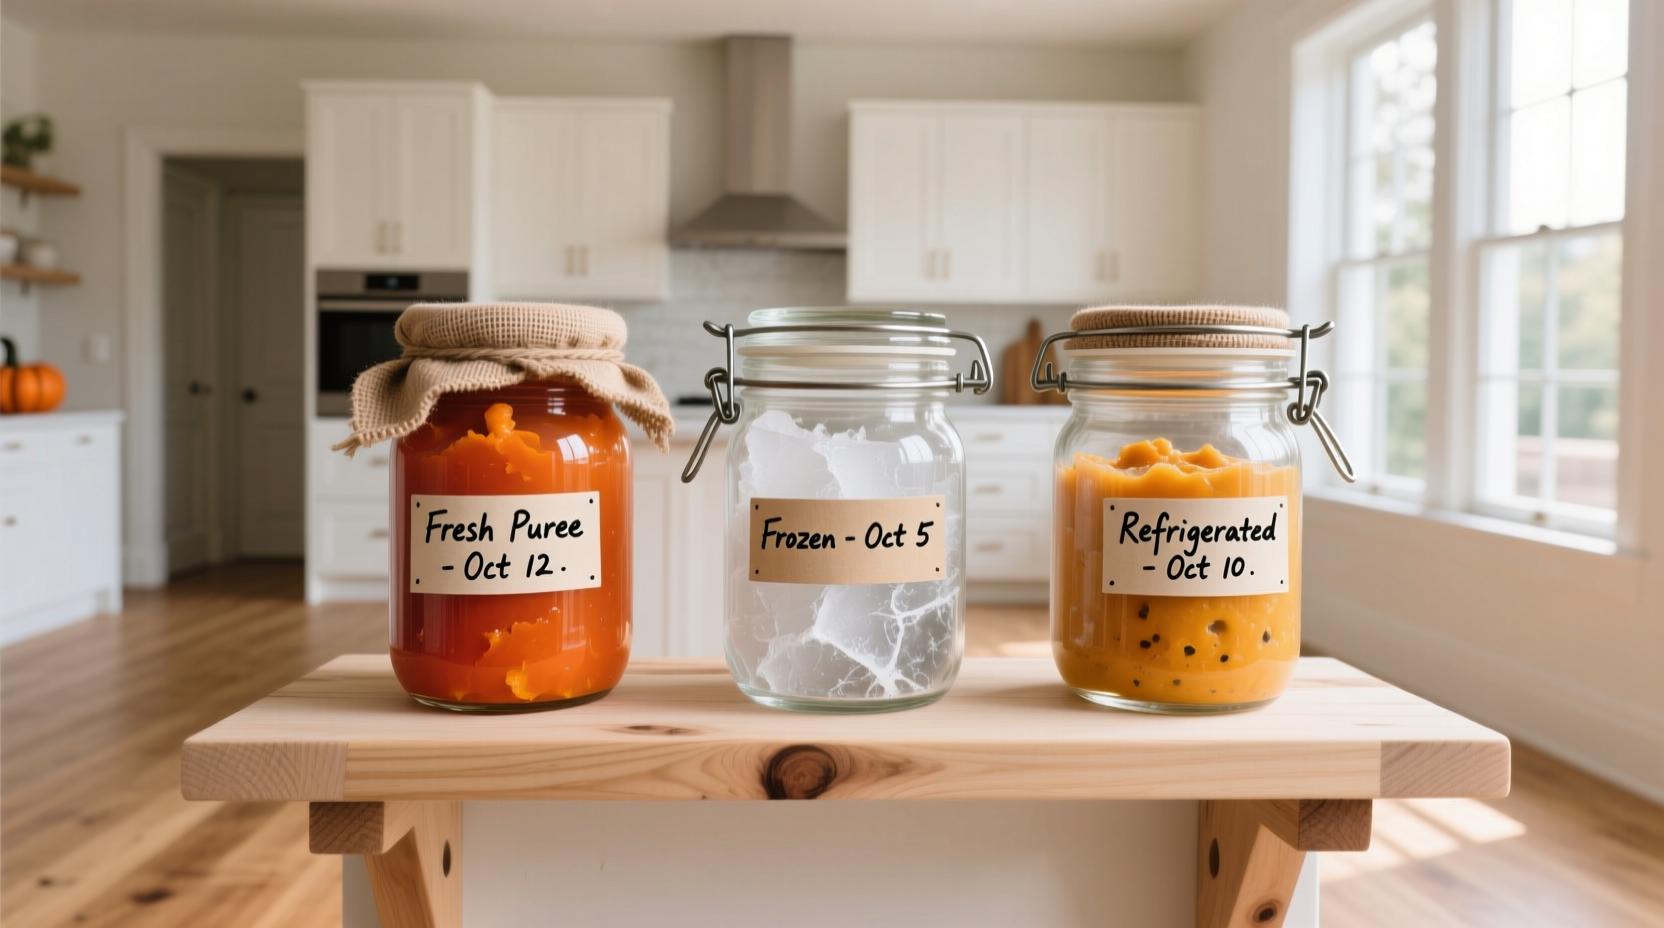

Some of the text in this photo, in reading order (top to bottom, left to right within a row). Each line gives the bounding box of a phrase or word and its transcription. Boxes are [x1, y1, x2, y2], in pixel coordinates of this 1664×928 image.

[425, 508, 585, 544] Fresh Puree
[760, 516, 836, 551] Frozen
[864, 521, 907, 550] Oct
[915, 520, 934, 548] 5
[1118, 510, 1277, 557] Refrigerated
[463, 550, 511, 581] Oct
[1166, 554, 1211, 581] Oct
